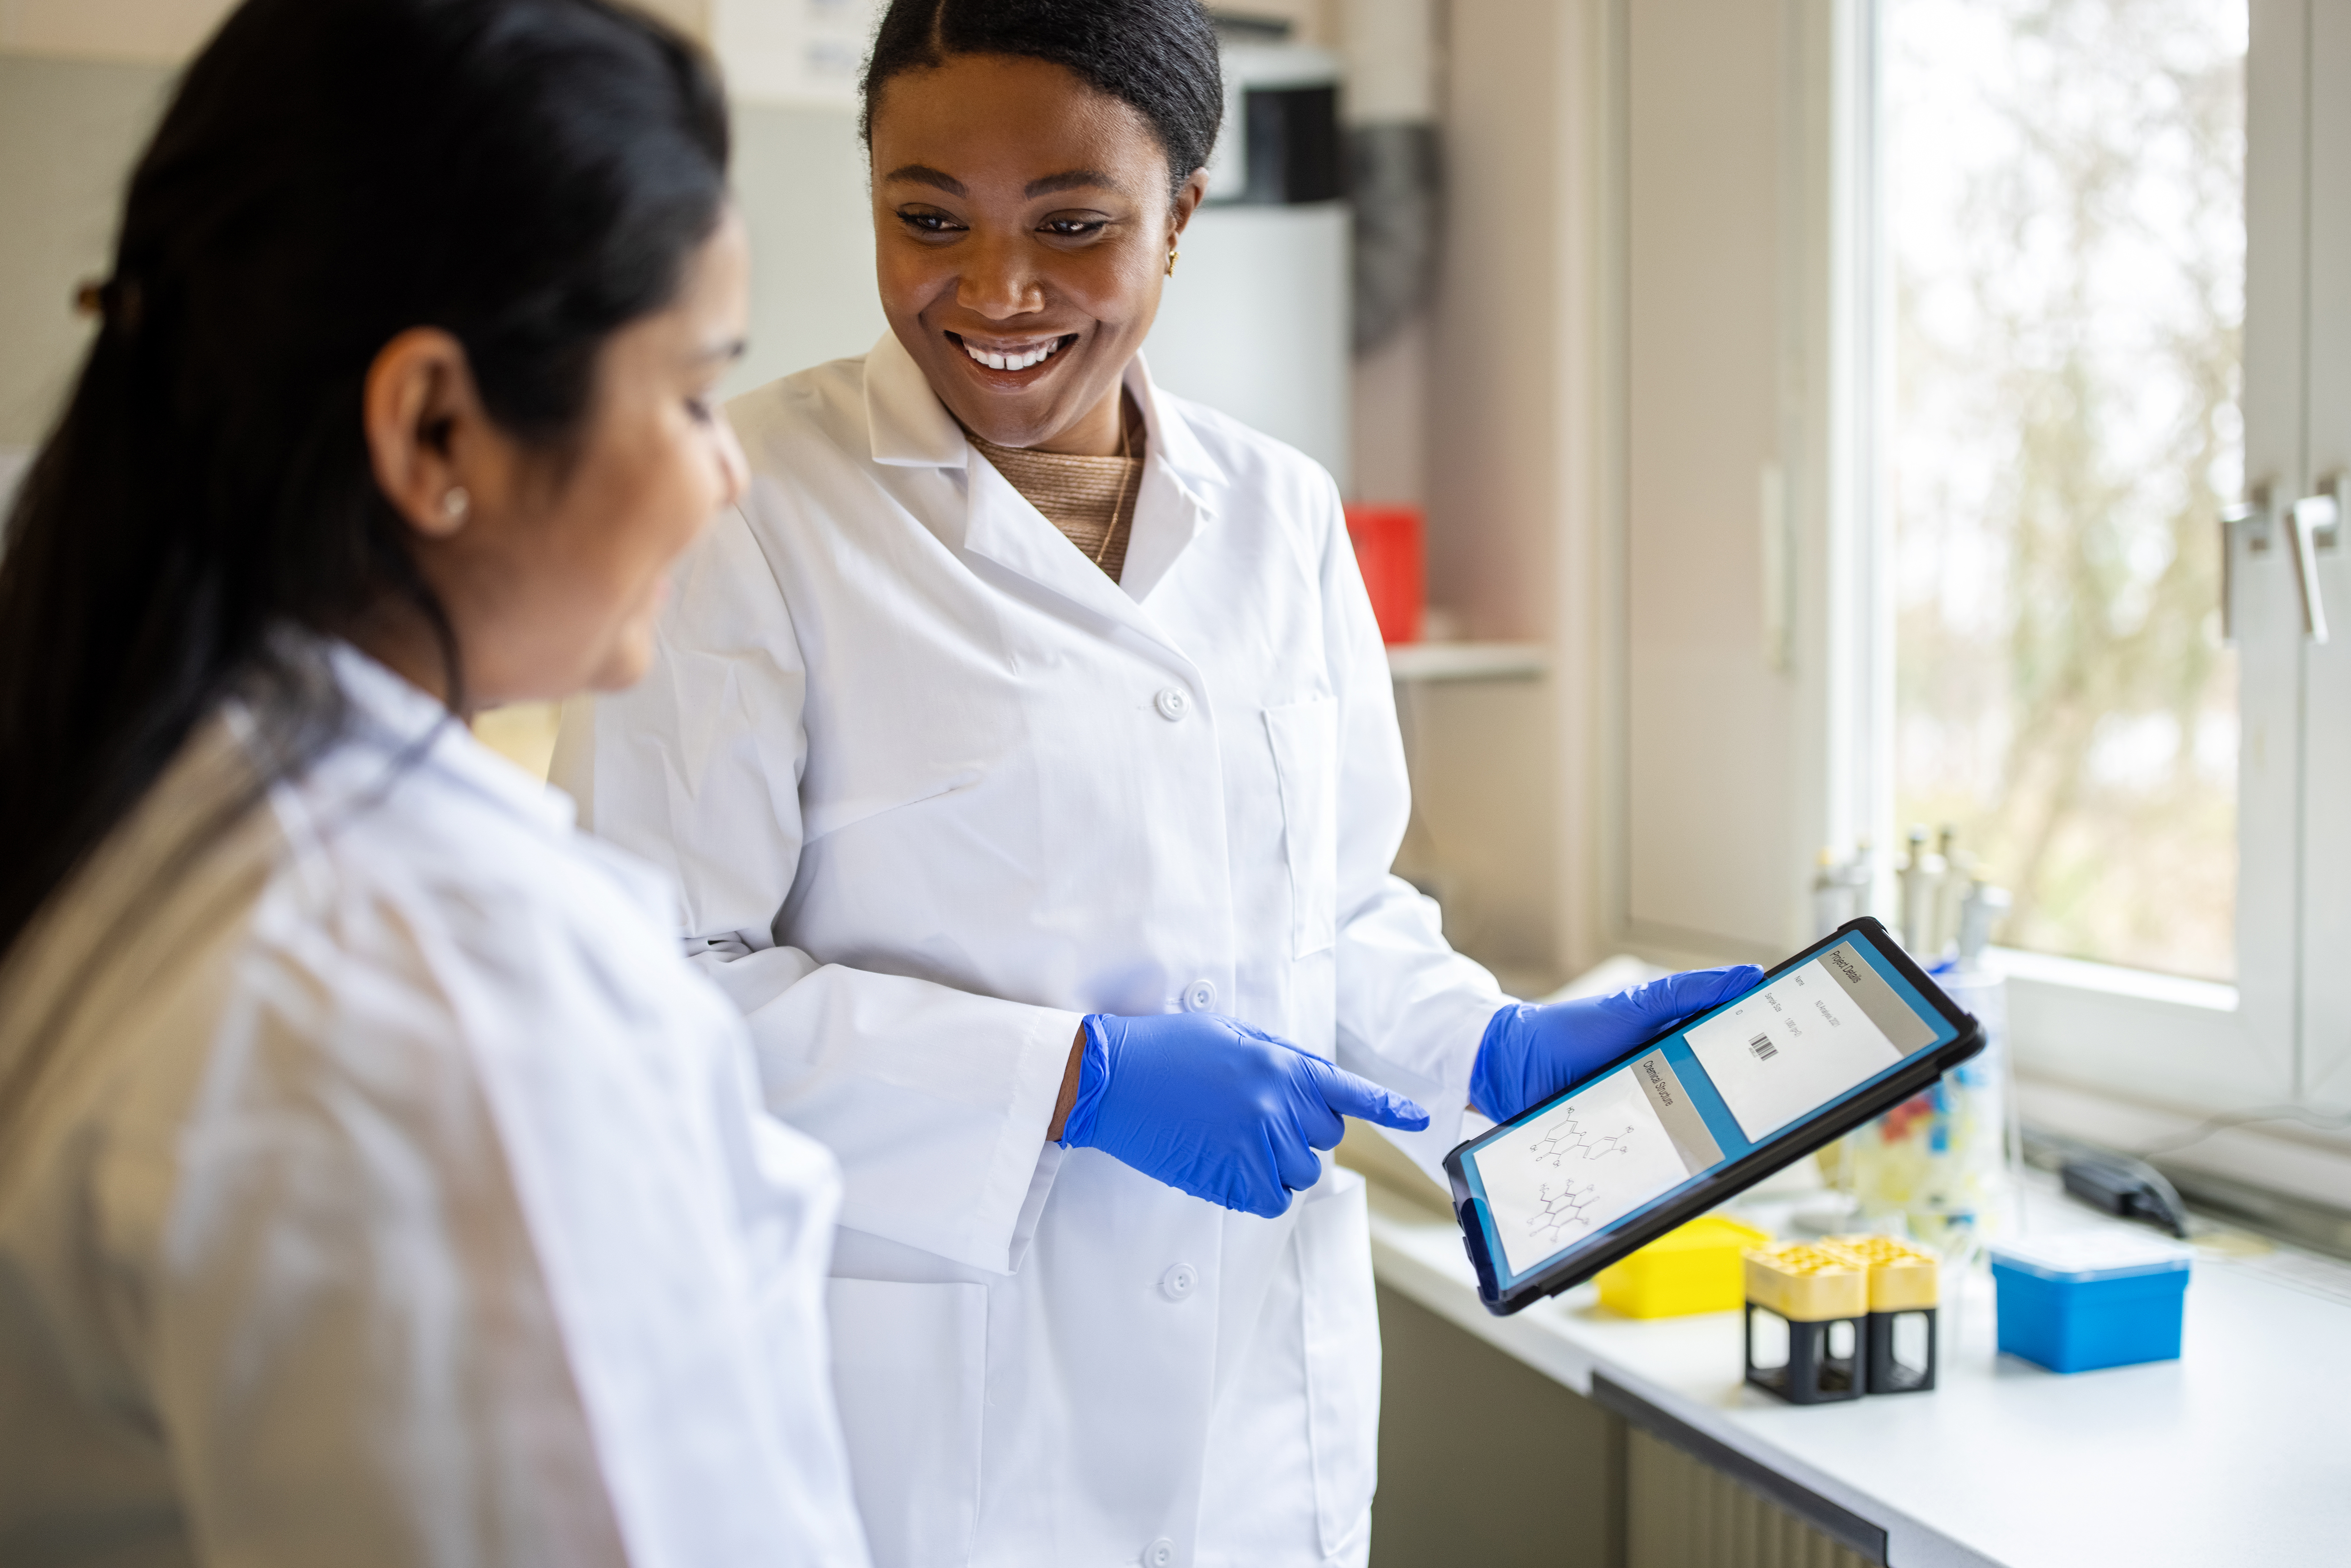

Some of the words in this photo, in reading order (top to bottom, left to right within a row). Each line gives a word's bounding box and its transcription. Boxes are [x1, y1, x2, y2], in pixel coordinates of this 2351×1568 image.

[1829, 950, 1849, 969] Project
[1842, 965, 1862, 983] Details
[1794, 975, 1805, 986] Name
[1764, 992, 1776, 1006] Sample
[1773, 1003, 1782, 1012] Size
[1818, 1005, 1832, 1020] Analysis
[1784, 1017, 1796, 1028] 1,000
[1643, 1060, 1663, 1084] Chemical
[1655, 1081, 1673, 1106] Structure
[1529, 1144, 1538, 1152] OH
[1619, 1146, 1627, 1155] OH
[1552, 1159, 1561, 1168] OH
